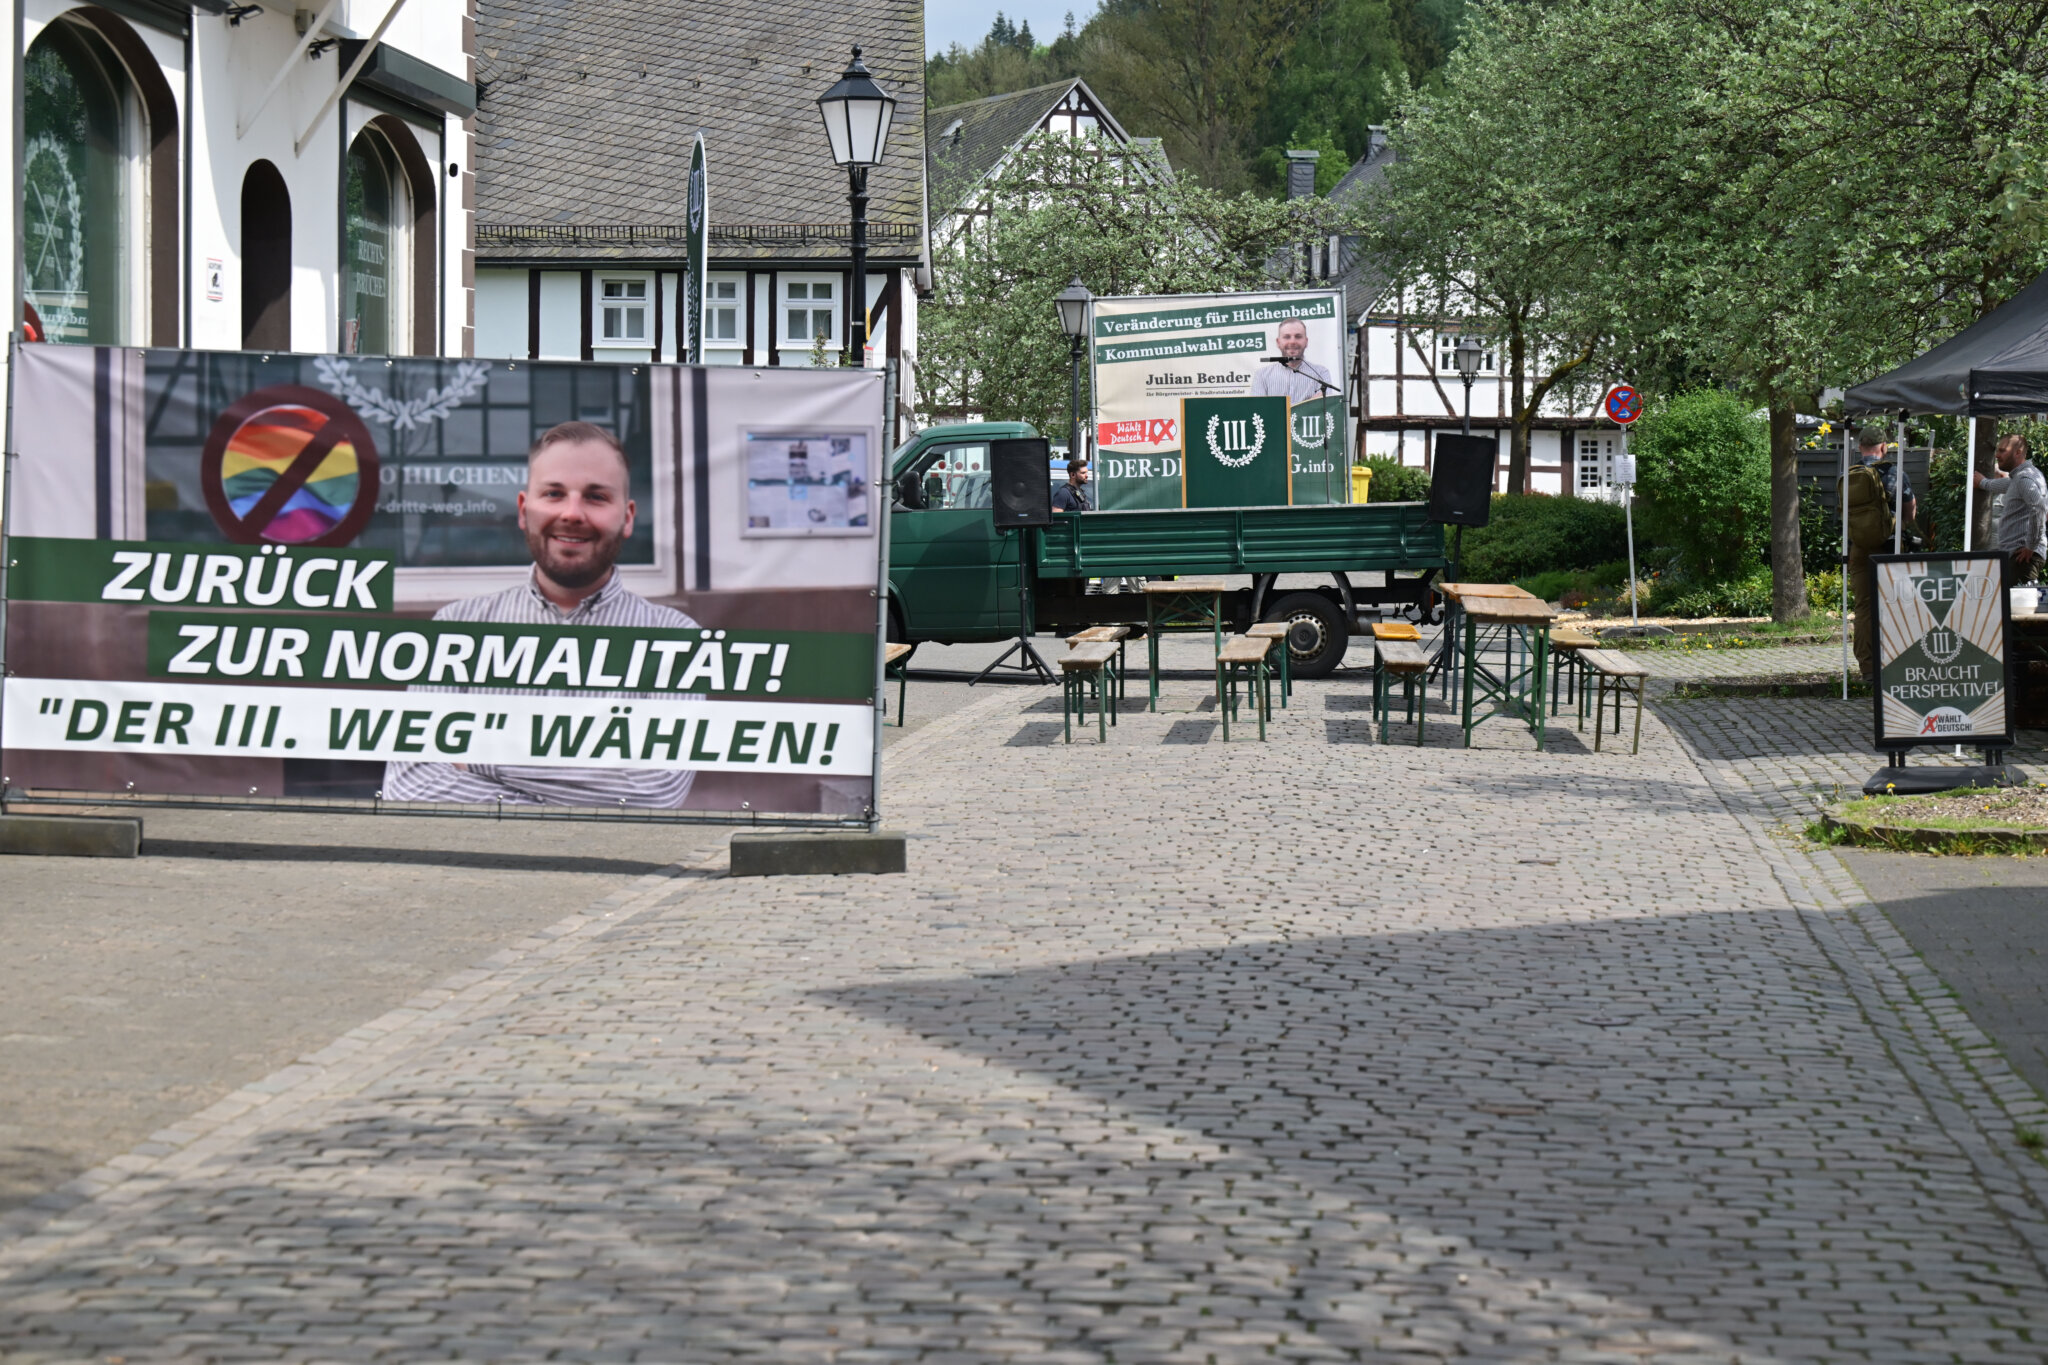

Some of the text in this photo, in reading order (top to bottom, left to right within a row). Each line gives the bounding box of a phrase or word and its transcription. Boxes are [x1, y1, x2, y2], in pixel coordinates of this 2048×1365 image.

[1103, 303, 1332, 333] Veränderung für Hilchenbach!
[1105, 337, 1264, 361] Kommunalwahl 2025
[1145, 371, 1251, 386] Julian Bender
[1117, 421, 1142, 434] Wählt
[1110, 432, 1142, 445] Deutsch
[101, 544, 389, 609] ZURÜCK
[1886, 575, 1994, 605] JUGEND
[167, 624, 790, 693] ZUR NORMALITÄT!
[1905, 665, 1981, 682] BRAUCHT
[1890, 681, 1998, 699] PERSPEKTIVE!
[1937, 723, 1973, 732] DEUTSCH!
[1938, 714, 1961, 723] WÄHLT
[38, 697, 840, 766] "DER III. WEG" WÄHLEN!
